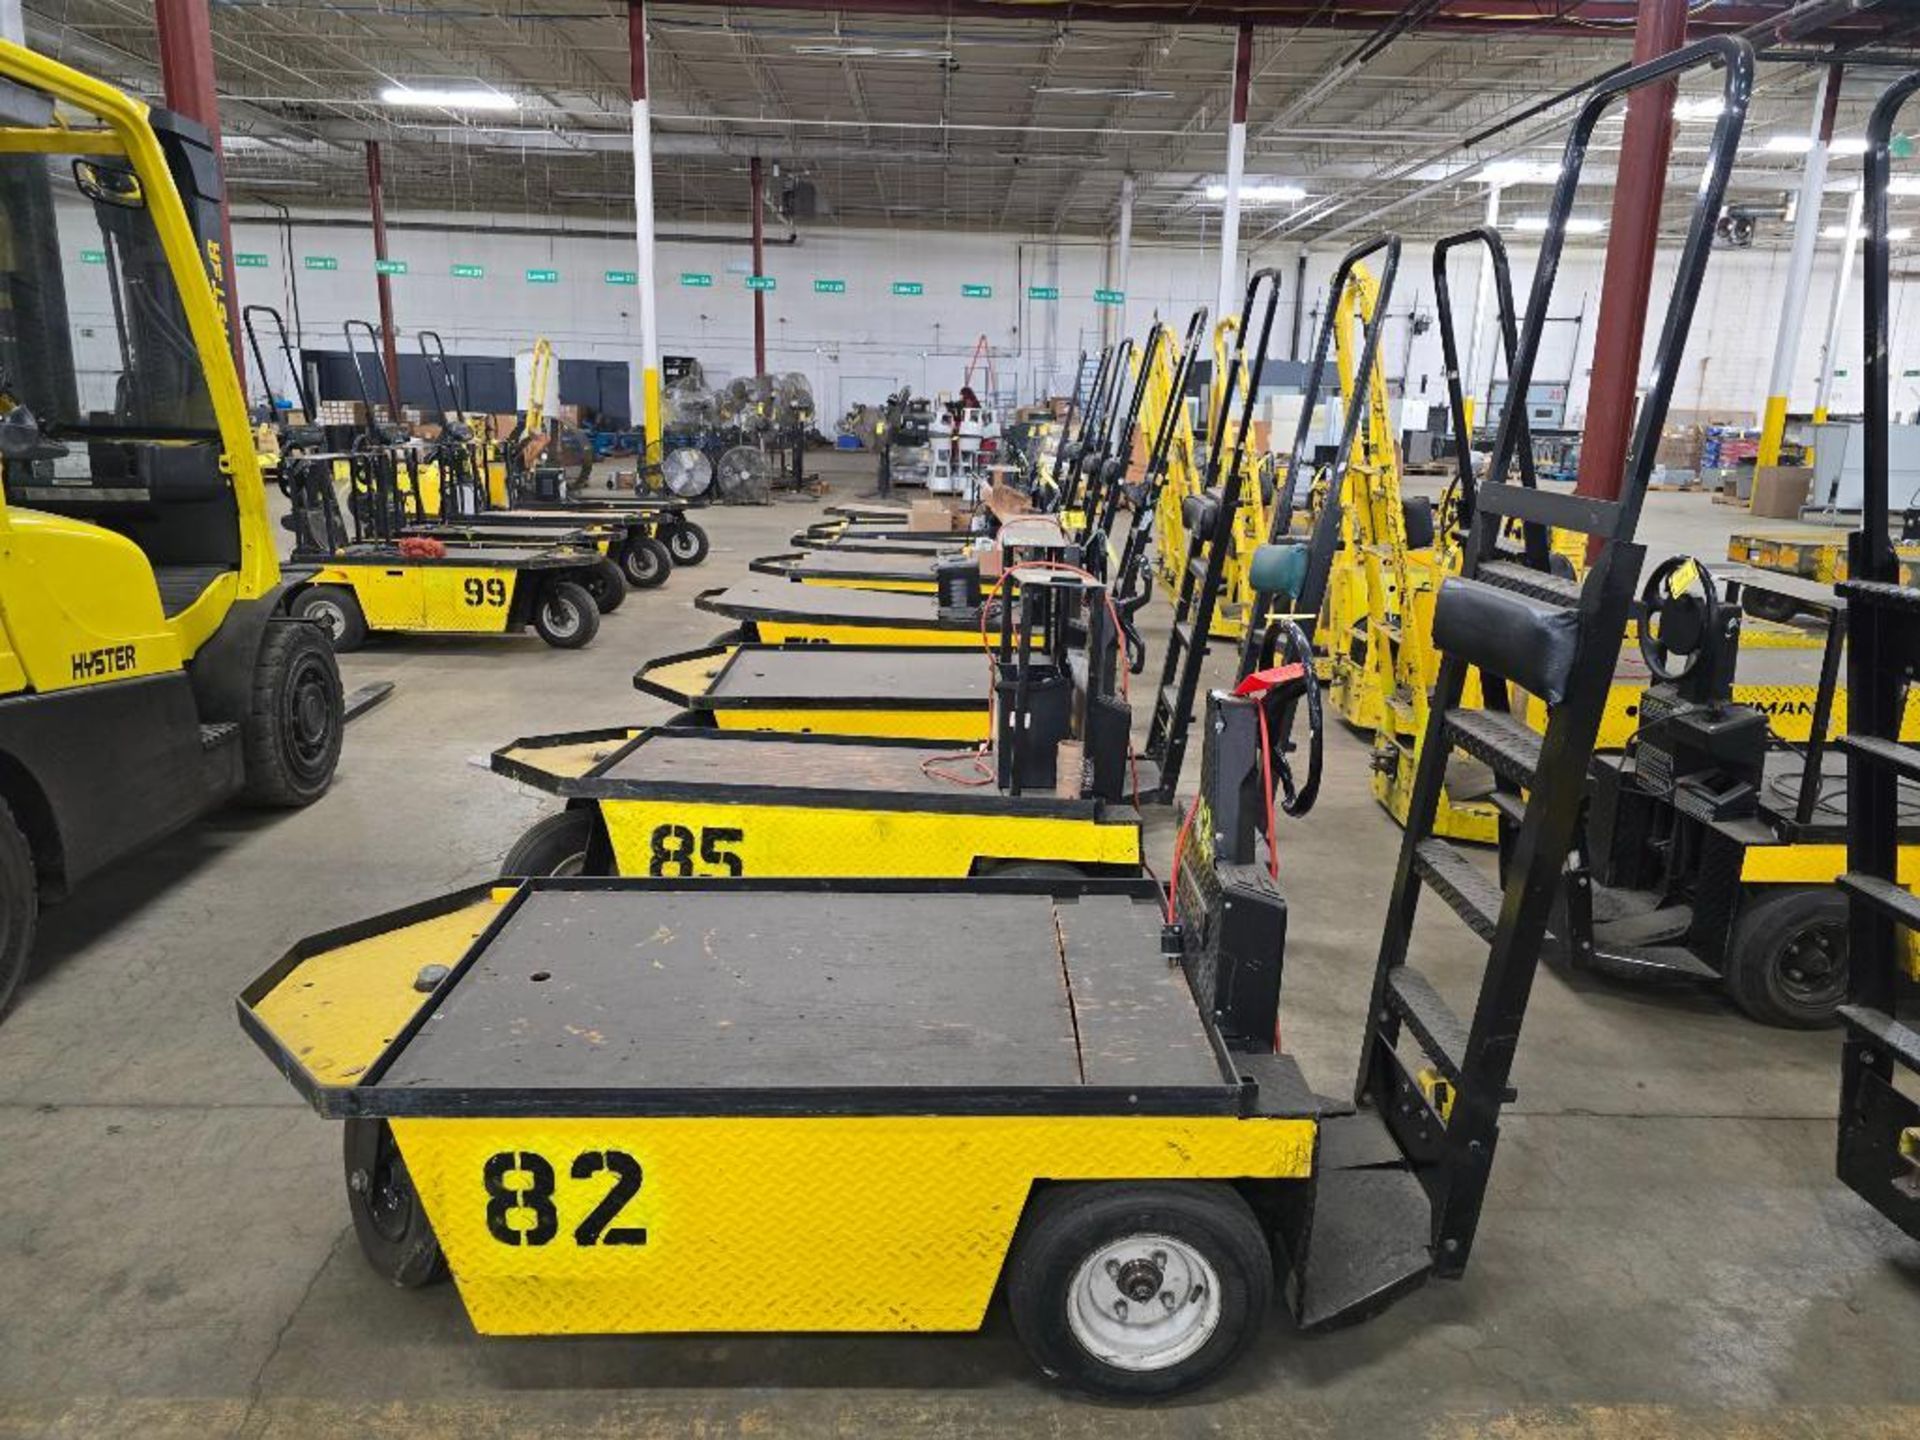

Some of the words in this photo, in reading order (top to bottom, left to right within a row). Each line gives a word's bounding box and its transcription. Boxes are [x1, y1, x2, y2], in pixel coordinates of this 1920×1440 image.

[464, 577, 506, 607] 99
[72, 644, 136, 680] HYSTER
[1749, 701, 1816, 714] MAN
[650, 823, 744, 877] 85
[483, 1151, 648, 1247] 82
